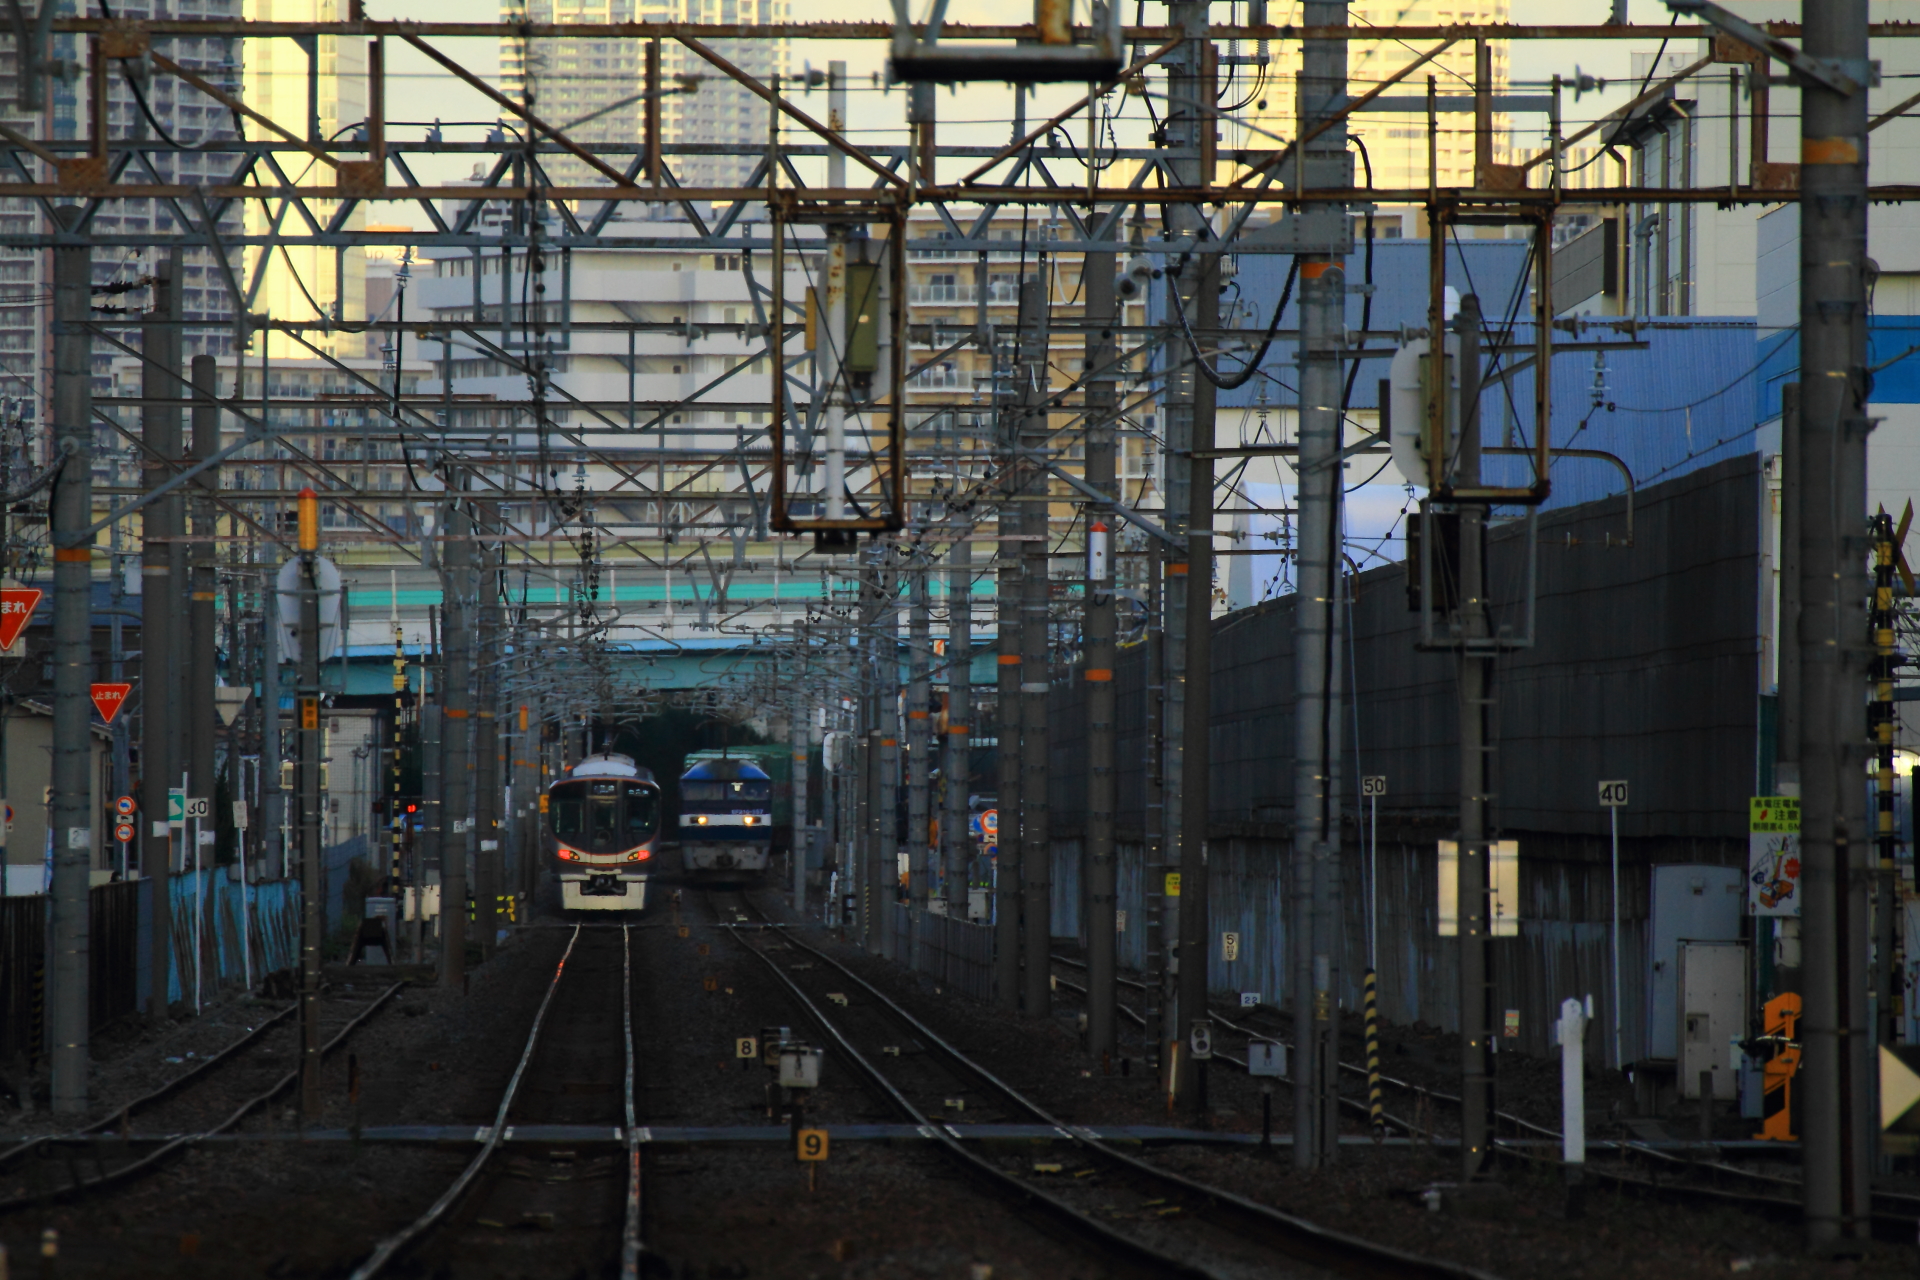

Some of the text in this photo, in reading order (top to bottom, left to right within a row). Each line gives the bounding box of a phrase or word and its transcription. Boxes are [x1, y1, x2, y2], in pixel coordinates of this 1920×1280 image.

[94, 691, 122, 701] 止まれ
[1364, 778, 1384, 793] 50
[1601, 783, 1627, 802] 40
[187, 800, 207, 814] 30
[1774, 809, 1799, 821] 注意
[1226, 934, 1234, 945] 5
[1244, 996, 1258, 1004] 22
[741, 1040, 752, 1055] 8
[804, 1133, 821, 1156] 9
